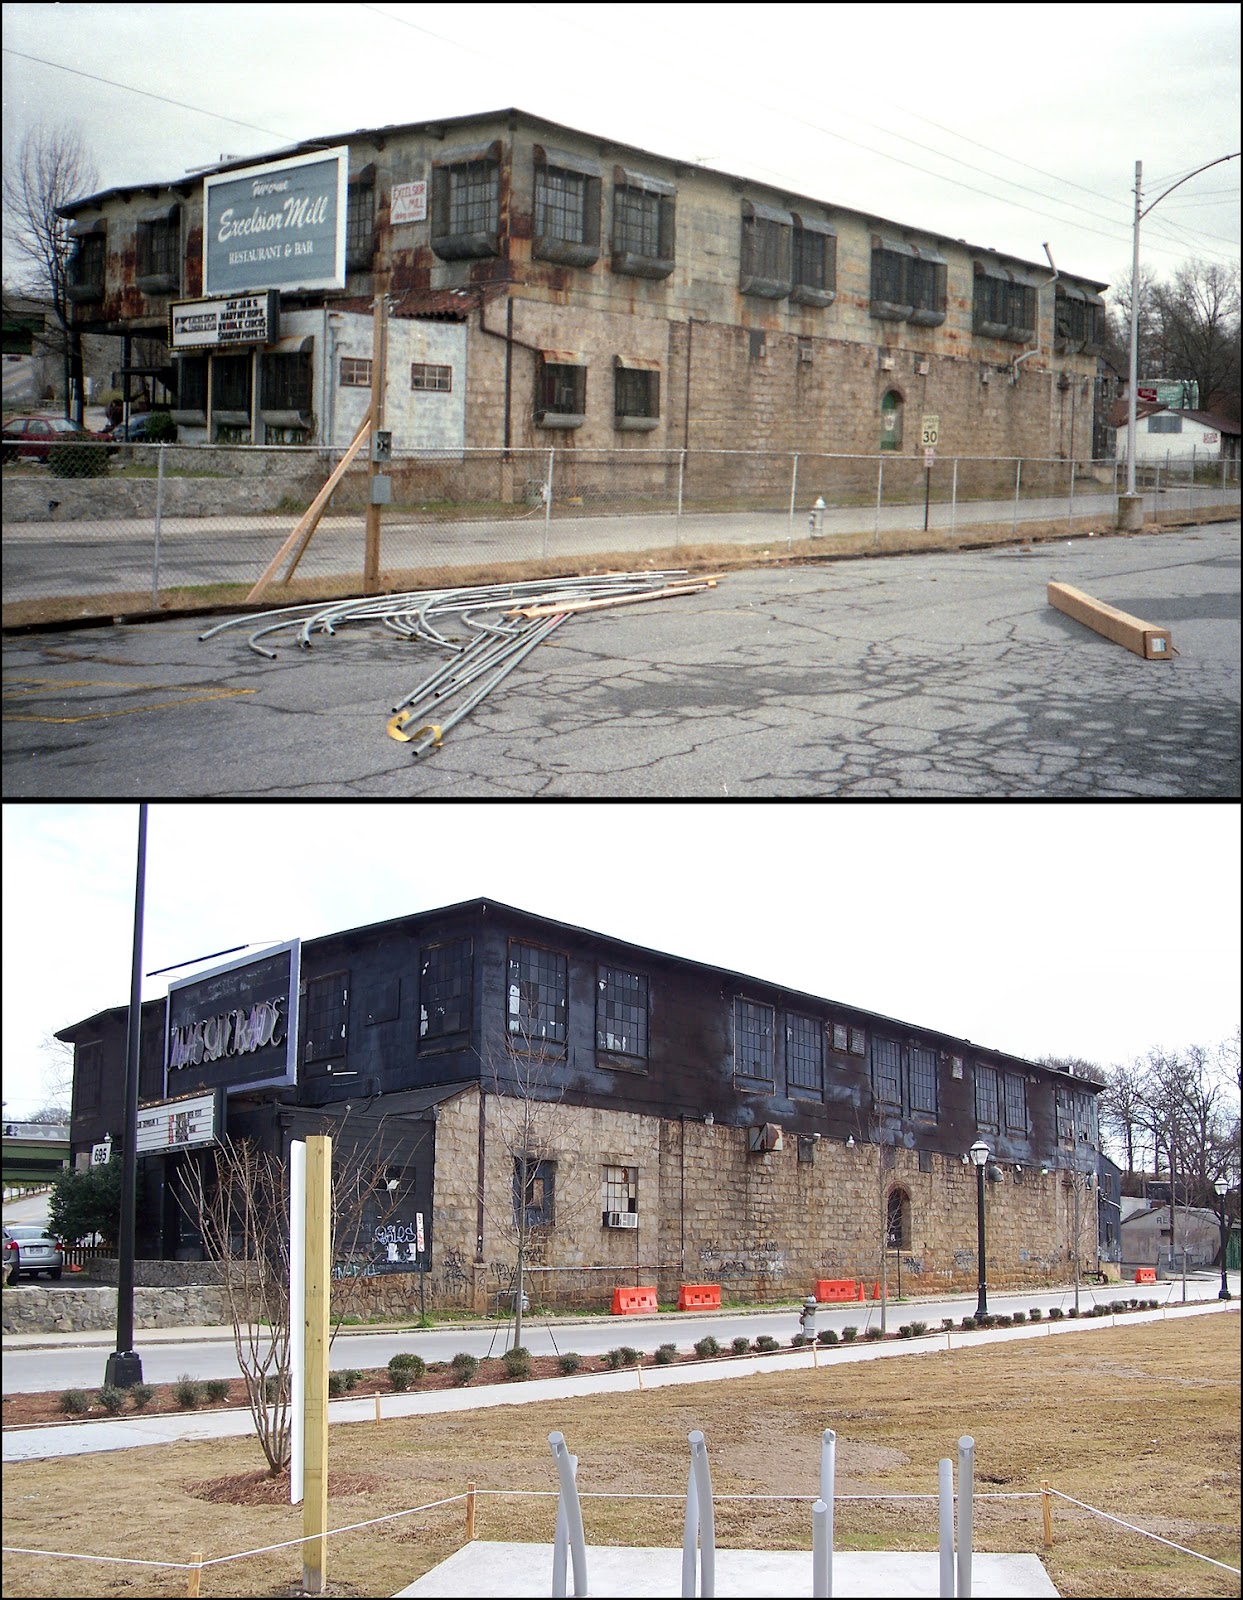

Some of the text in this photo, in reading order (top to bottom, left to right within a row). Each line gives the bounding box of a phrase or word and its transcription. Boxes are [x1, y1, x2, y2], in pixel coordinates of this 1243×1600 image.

[218, 196, 328, 242] Excelsior Mill
[229, 241, 313, 265] RESTAURANT & BAR
[923, 431, 937, 443] 30
[94, 1148, 108, 1162] 695
